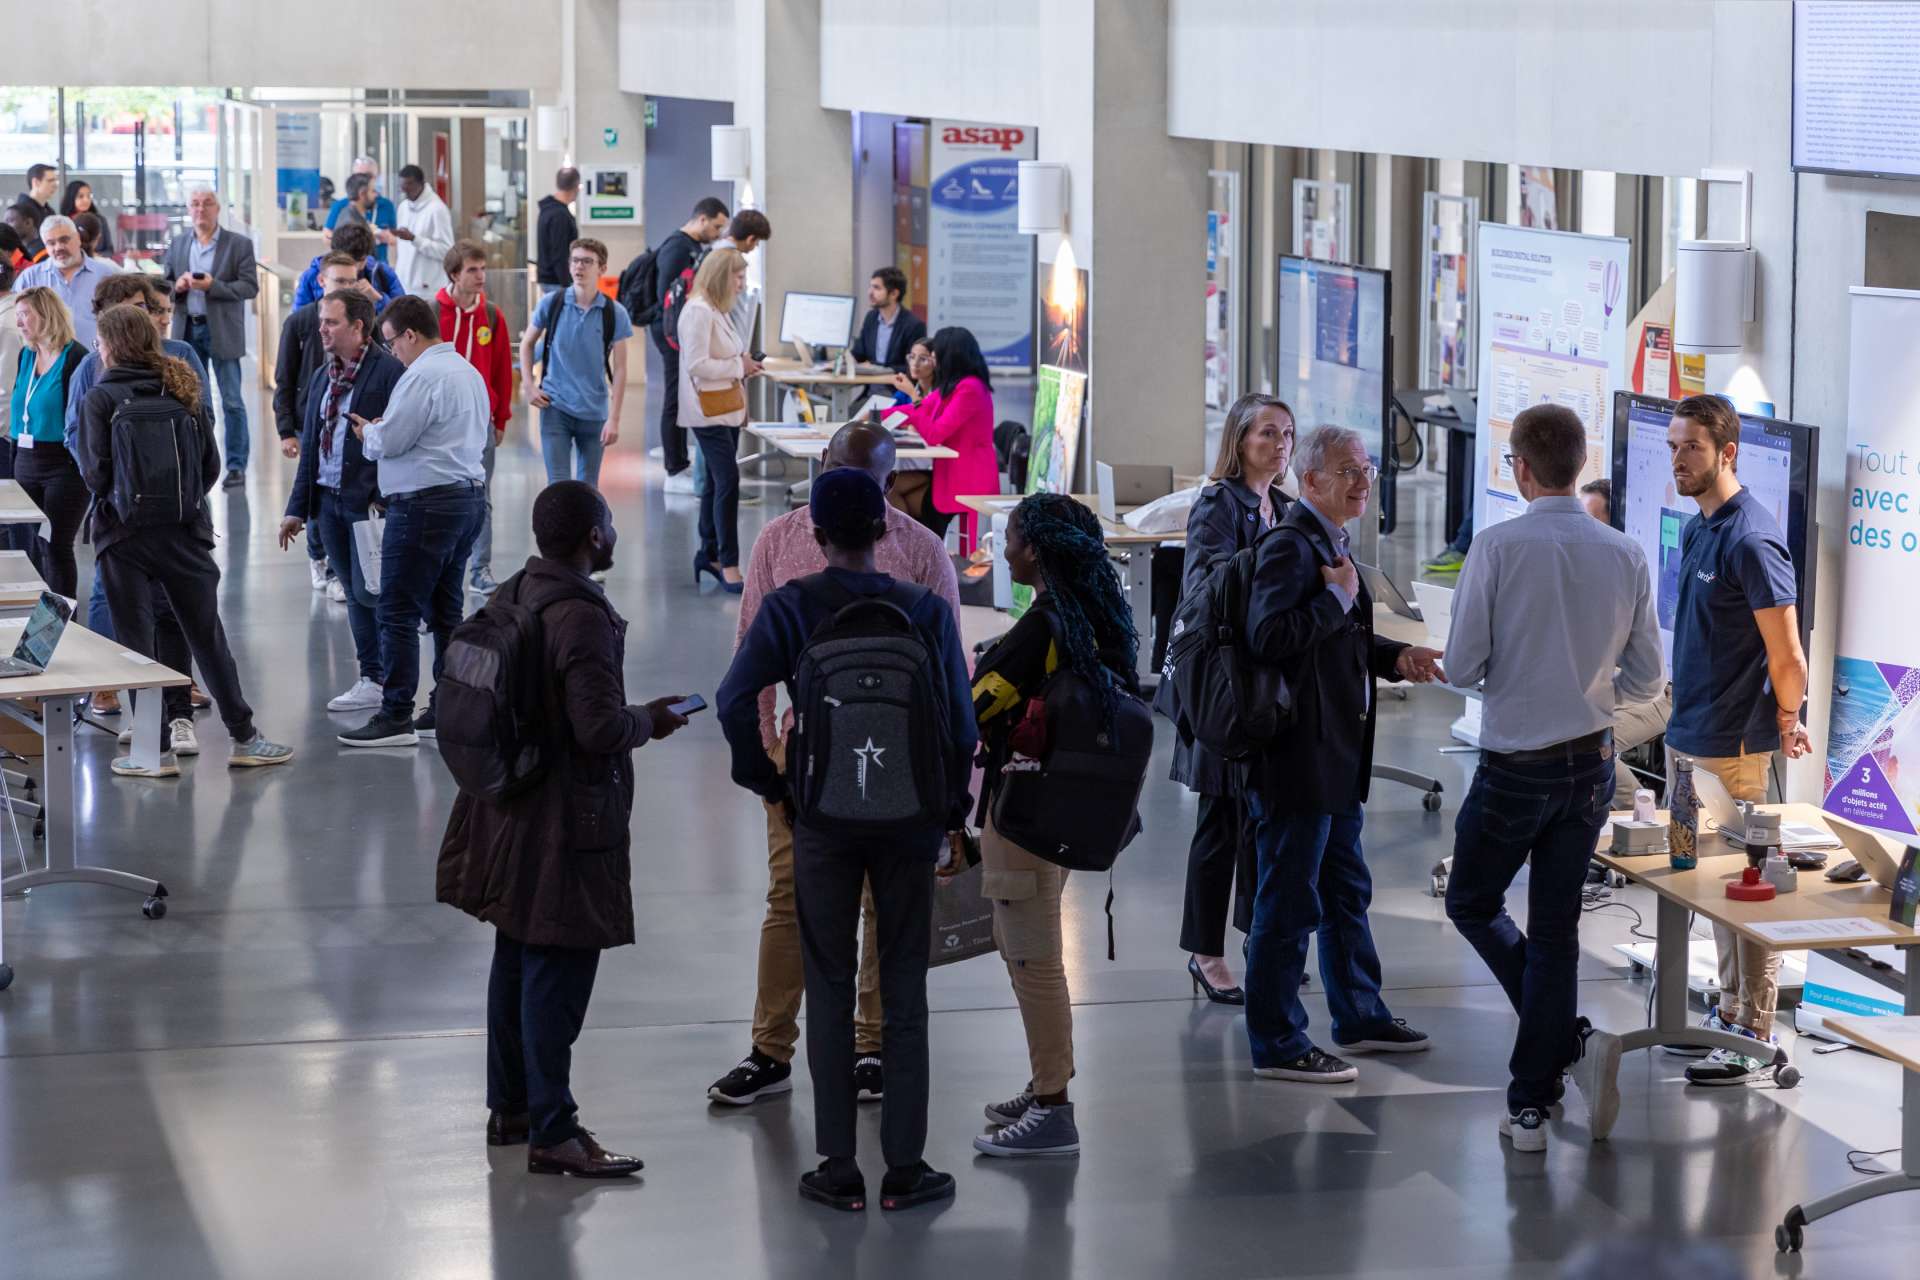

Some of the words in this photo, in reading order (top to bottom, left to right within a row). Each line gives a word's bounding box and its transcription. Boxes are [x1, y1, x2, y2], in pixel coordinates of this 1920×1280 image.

[942, 127, 1025, 151] asap
[1856, 444, 1909, 475] Tout
[1851, 486, 1909, 513] avec
[1850, 519, 1891, 549] des
[1861, 767, 1871, 784] 3
[1841, 795, 1868, 807] d'objets
[1869, 802, 1888, 811] actifs
[1851, 788, 1878, 799] millions
[1843, 807, 1852, 815] en
